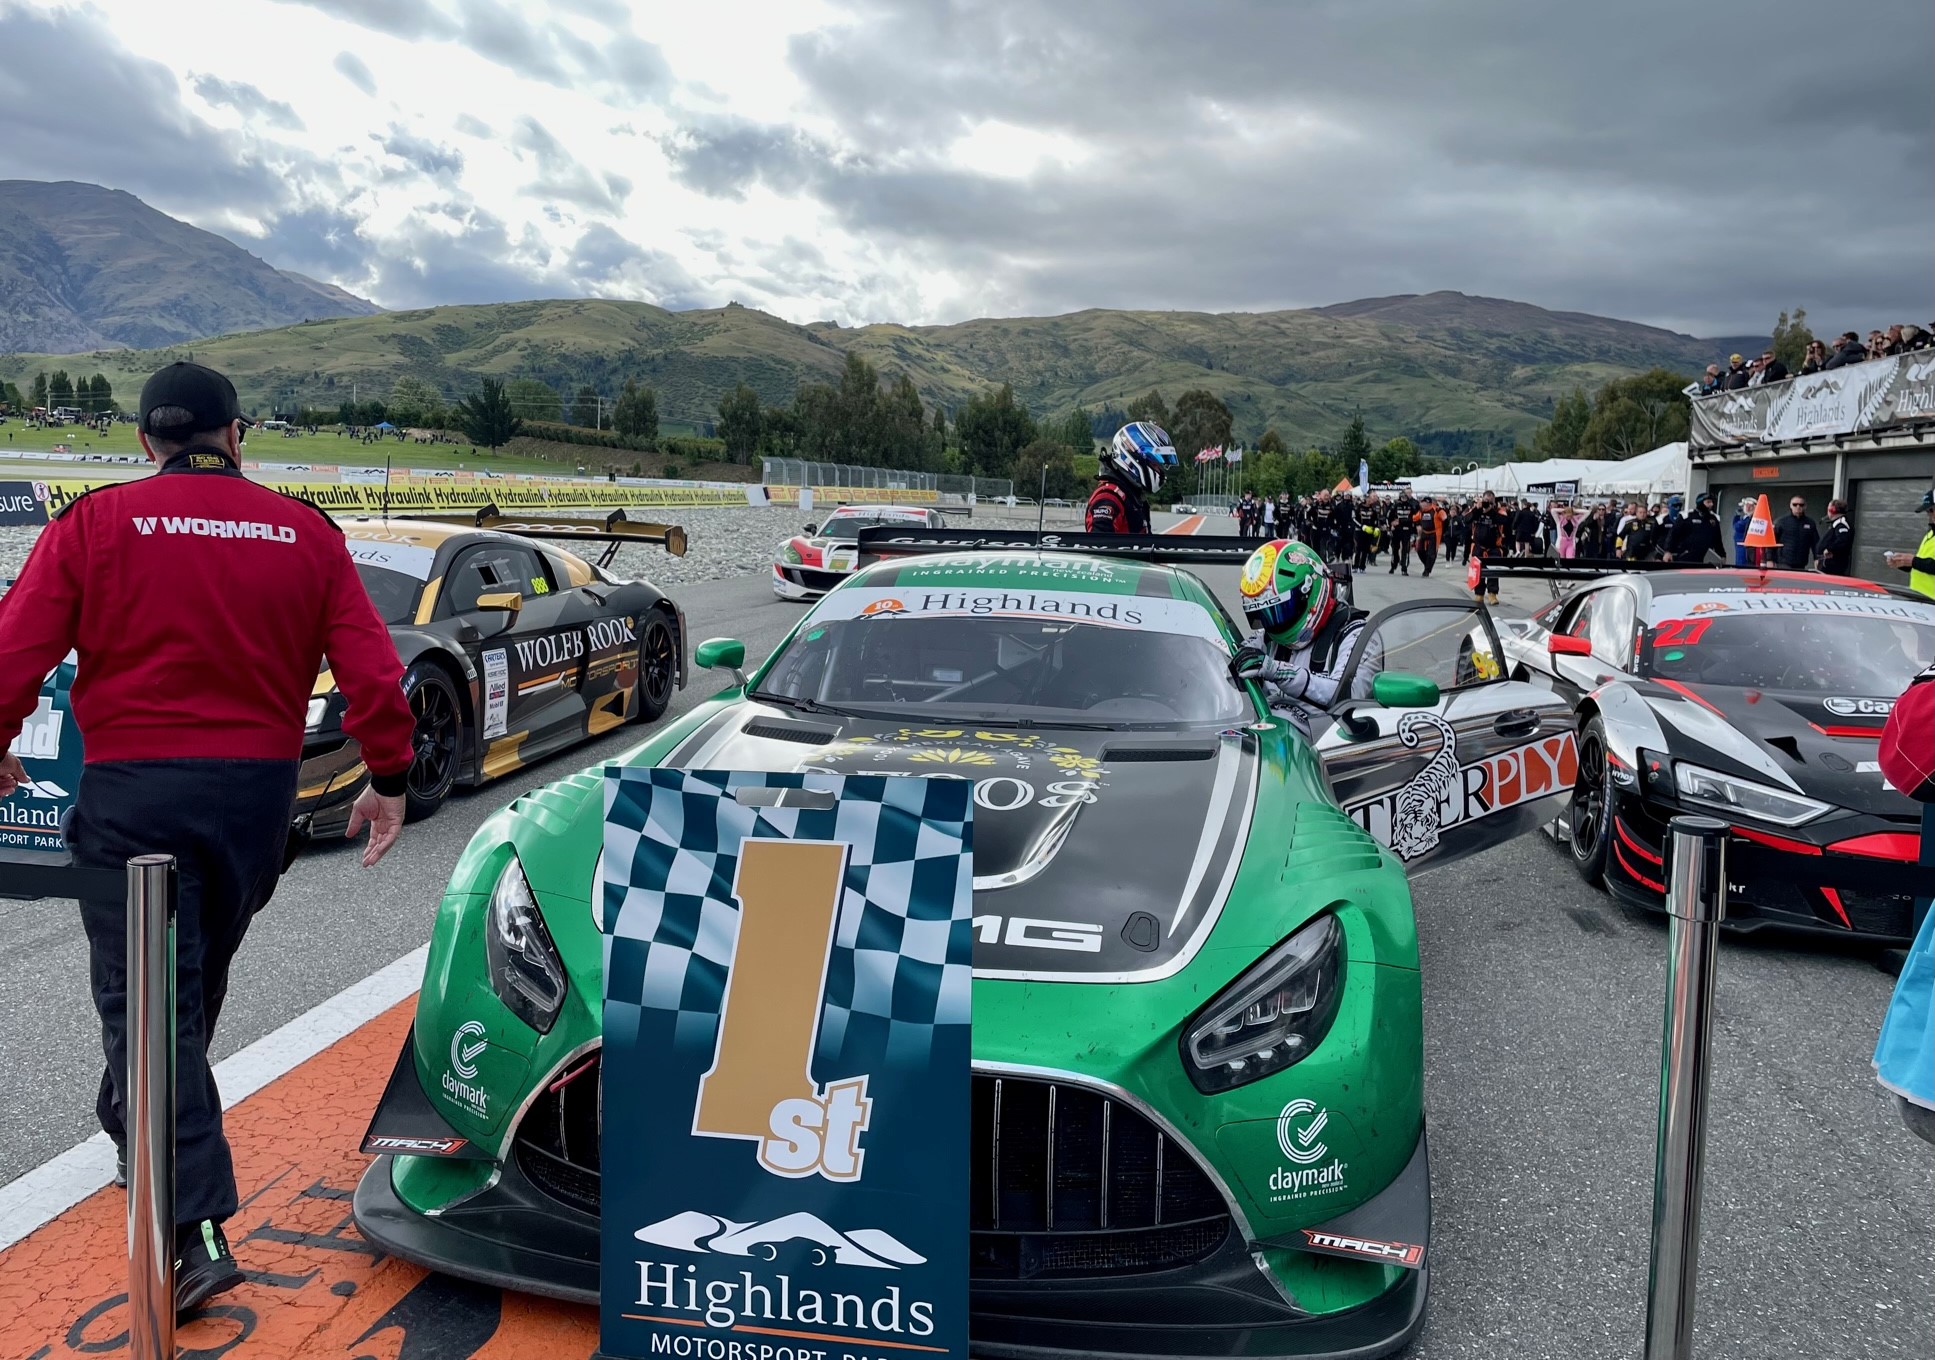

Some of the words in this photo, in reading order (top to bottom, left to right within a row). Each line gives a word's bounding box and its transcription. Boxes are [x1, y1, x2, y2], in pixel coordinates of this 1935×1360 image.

[1796, 401, 1845, 430] Highlands
[364, 487, 433, 506] Hydraulink
[434, 487, 492, 504] Hydraulink
[163, 517, 296, 543] WORMALD
[912, 568, 1008, 577] INGRAINED
[920, 594, 1143, 625] Highlands
[1738, 599, 1930, 620] Highlands
[1653, 618, 1712, 647] 27
[904, 740, 1000, 749] MEXICAN
[1001, 749, 1031, 770] AGAVE
[34, 836, 63, 848] PARK
[442, 1069, 487, 1109] claymark
[1269, 1158, 1344, 1193] claymark
[1270, 1192, 1307, 1202] INGRAINED
[634, 1260, 935, 1336] Highlands
